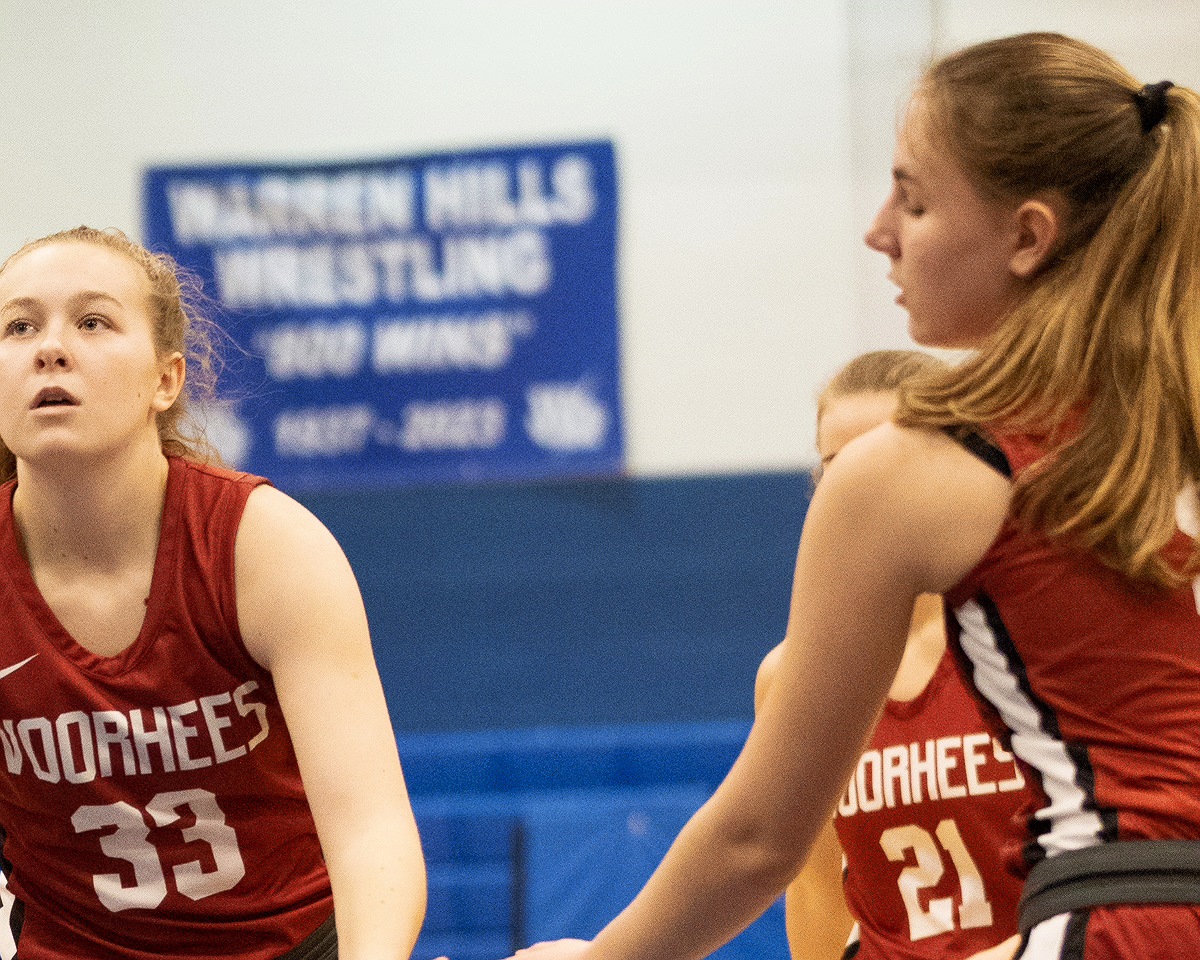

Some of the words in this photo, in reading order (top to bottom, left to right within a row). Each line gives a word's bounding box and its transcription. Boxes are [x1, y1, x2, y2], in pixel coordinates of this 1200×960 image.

[168, 170, 414, 246] WARREN
[425, 156, 594, 229] HILLS
[216, 233, 551, 307] WRESTLING
[70, 787, 246, 913] 33
[879, 818, 993, 942] 21
